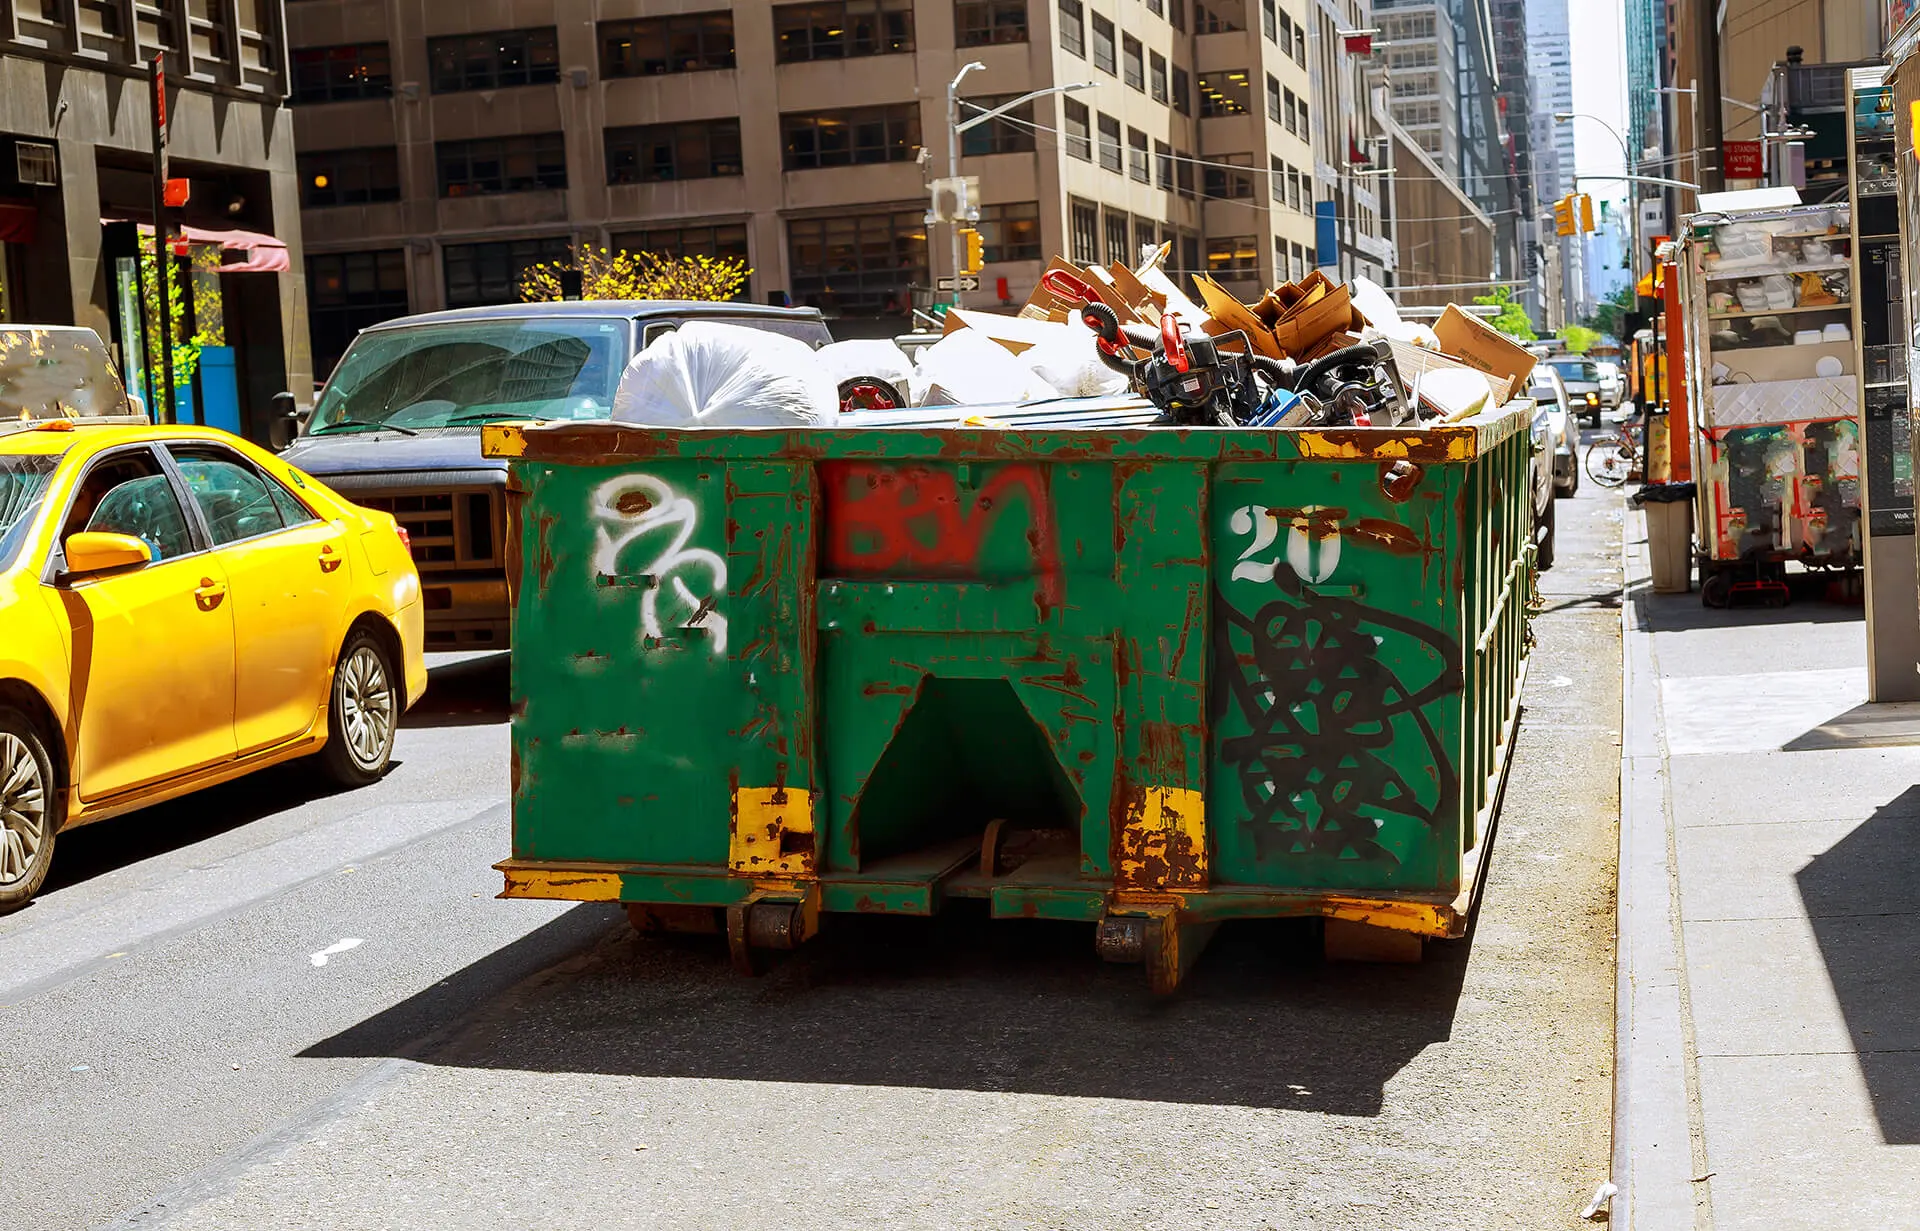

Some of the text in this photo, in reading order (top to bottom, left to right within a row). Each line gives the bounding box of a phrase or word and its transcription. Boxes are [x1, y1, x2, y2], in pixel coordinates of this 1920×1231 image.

[1729, 154, 1757, 163] ANYTIME
[1526, 240, 1538, 278] MoMA
[1893, 512, 1910, 520] Walk
[1230, 504, 1342, 584] 20
